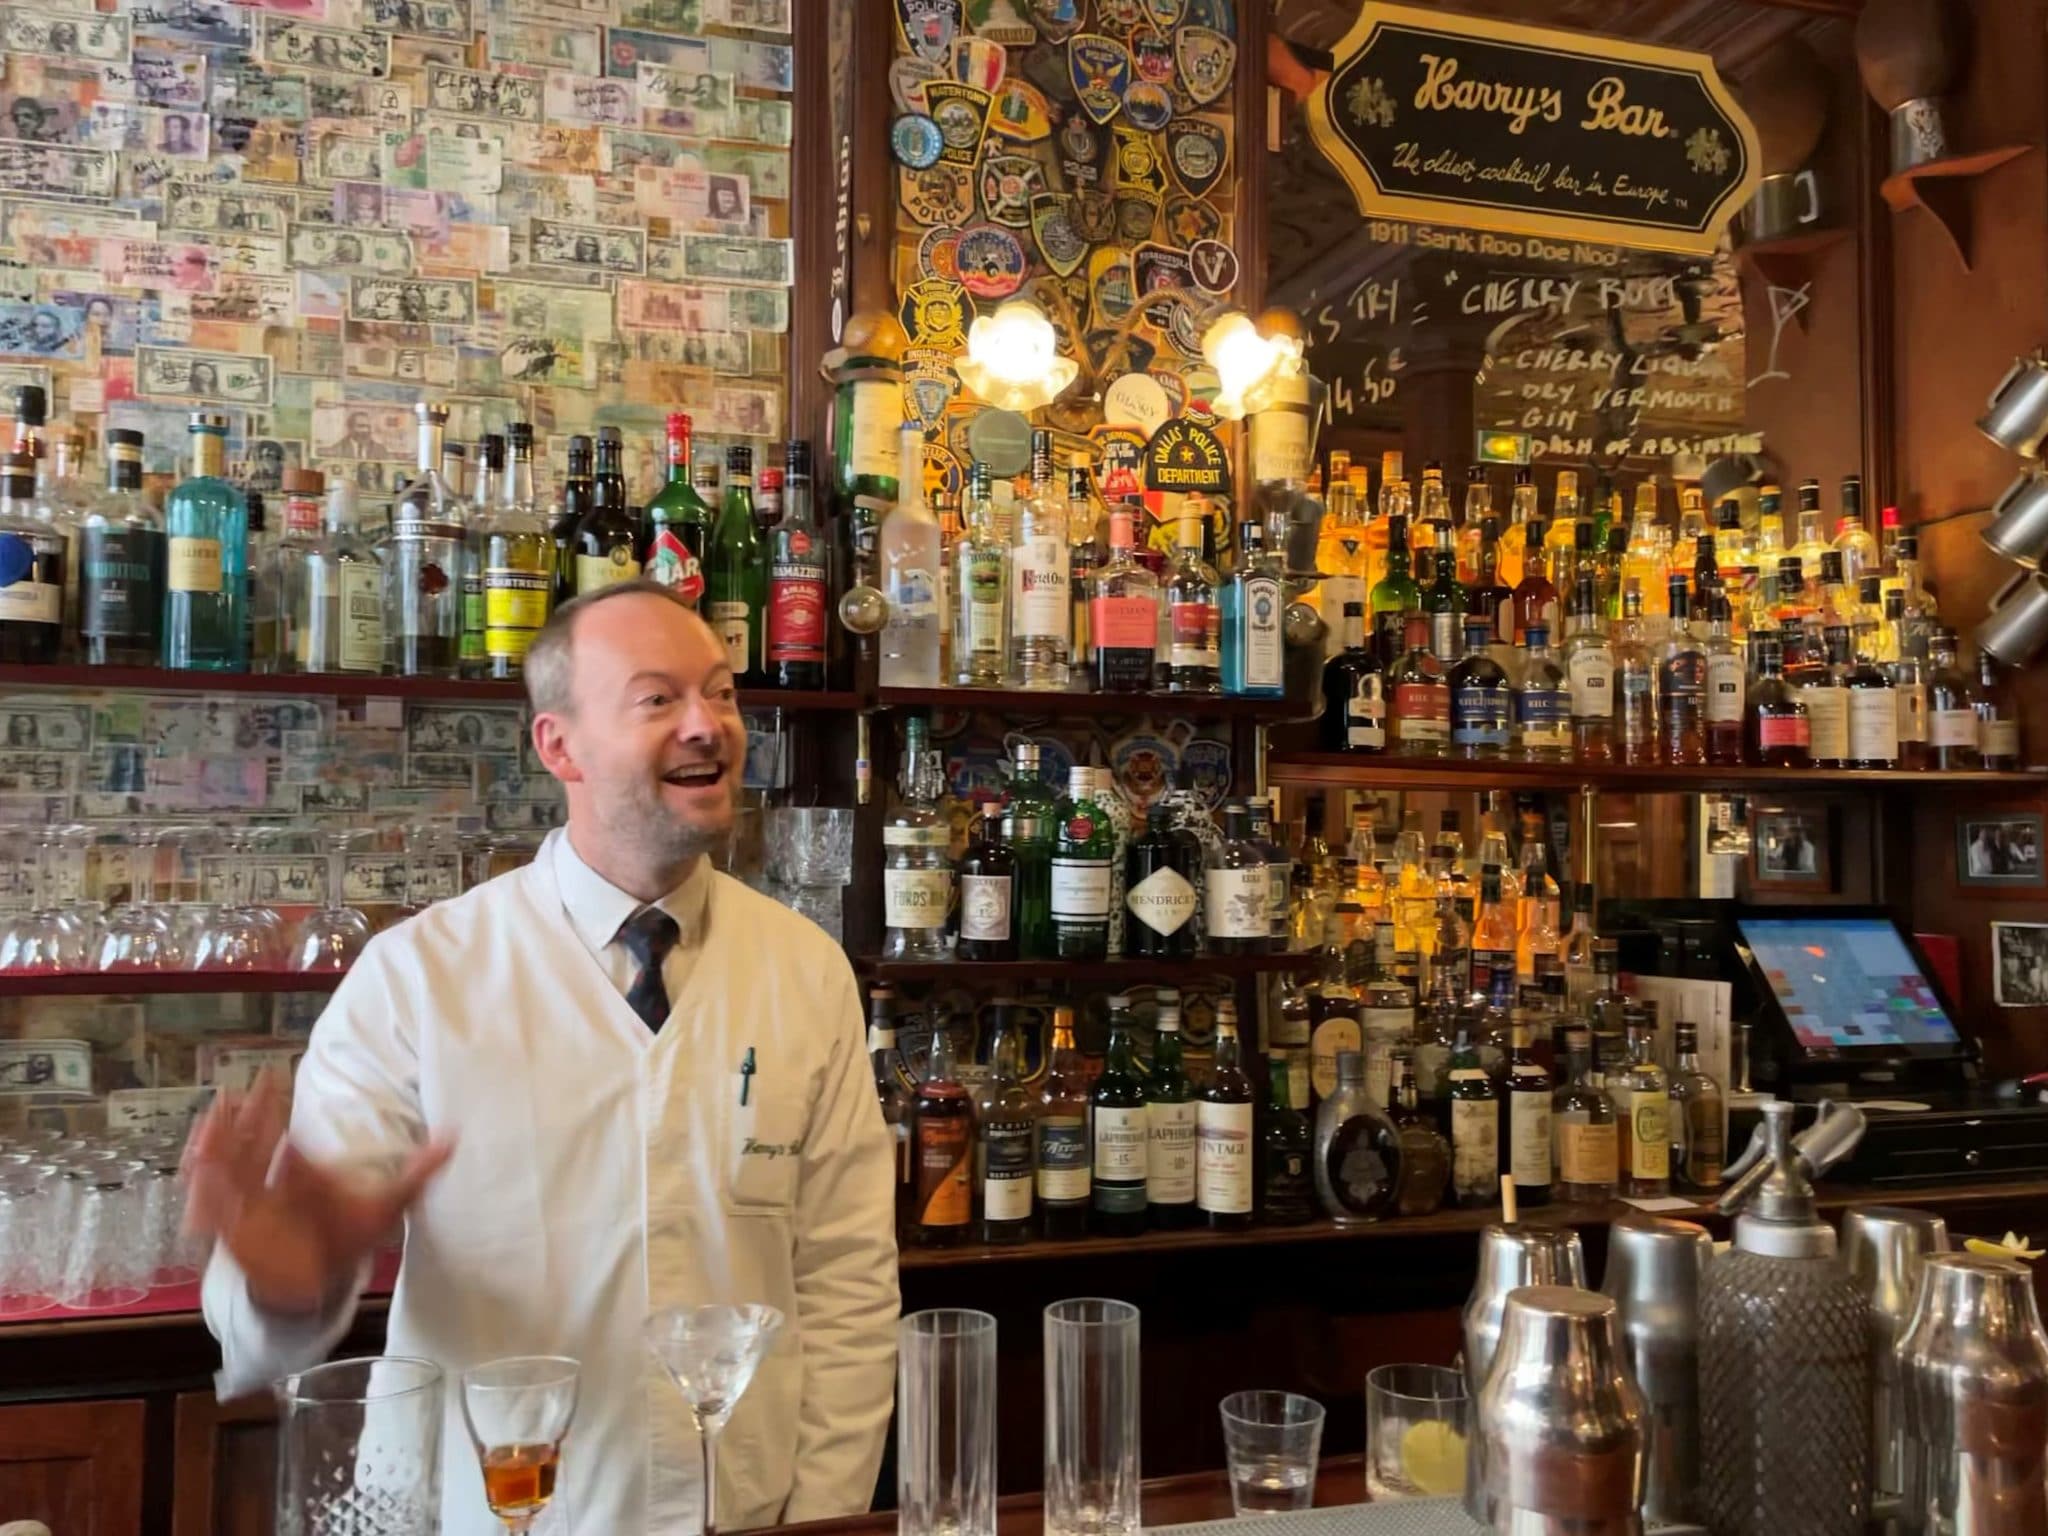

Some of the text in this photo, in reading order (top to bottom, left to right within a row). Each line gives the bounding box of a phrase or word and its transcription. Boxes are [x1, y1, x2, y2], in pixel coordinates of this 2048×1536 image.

[1414, 54, 1670, 138] Harry's Bar
[1392, 142, 1421, 176] The
[1423, 149, 1476, 182] oldest
[1477, 157, 1551, 193] cocktail
[1552, 165, 1582, 196] bar
[1583, 171, 1607, 196] in
[1612, 174, 1670, 210] Europe
[910, 196, 968, 223] POLICE
[1368, 221, 1618, 267] 1911 Sank Roo Doe Noo
[1197, 250, 1227, 285] V
[1346, 276, 1400, 325] TRY
[1461, 276, 1582, 315] CHERRY
[1515, 349, 1624, 383] CHERRY
[1521, 382, 1733, 412] DRY VERMOUTH
[1154, 425, 1222, 466] DALLAS POLICE
[1157, 467, 1220, 484] DEPARTMENT
[893, 890, 928, 907] FORDS
[1201, 1142, 1246, 1154] INTAGE
